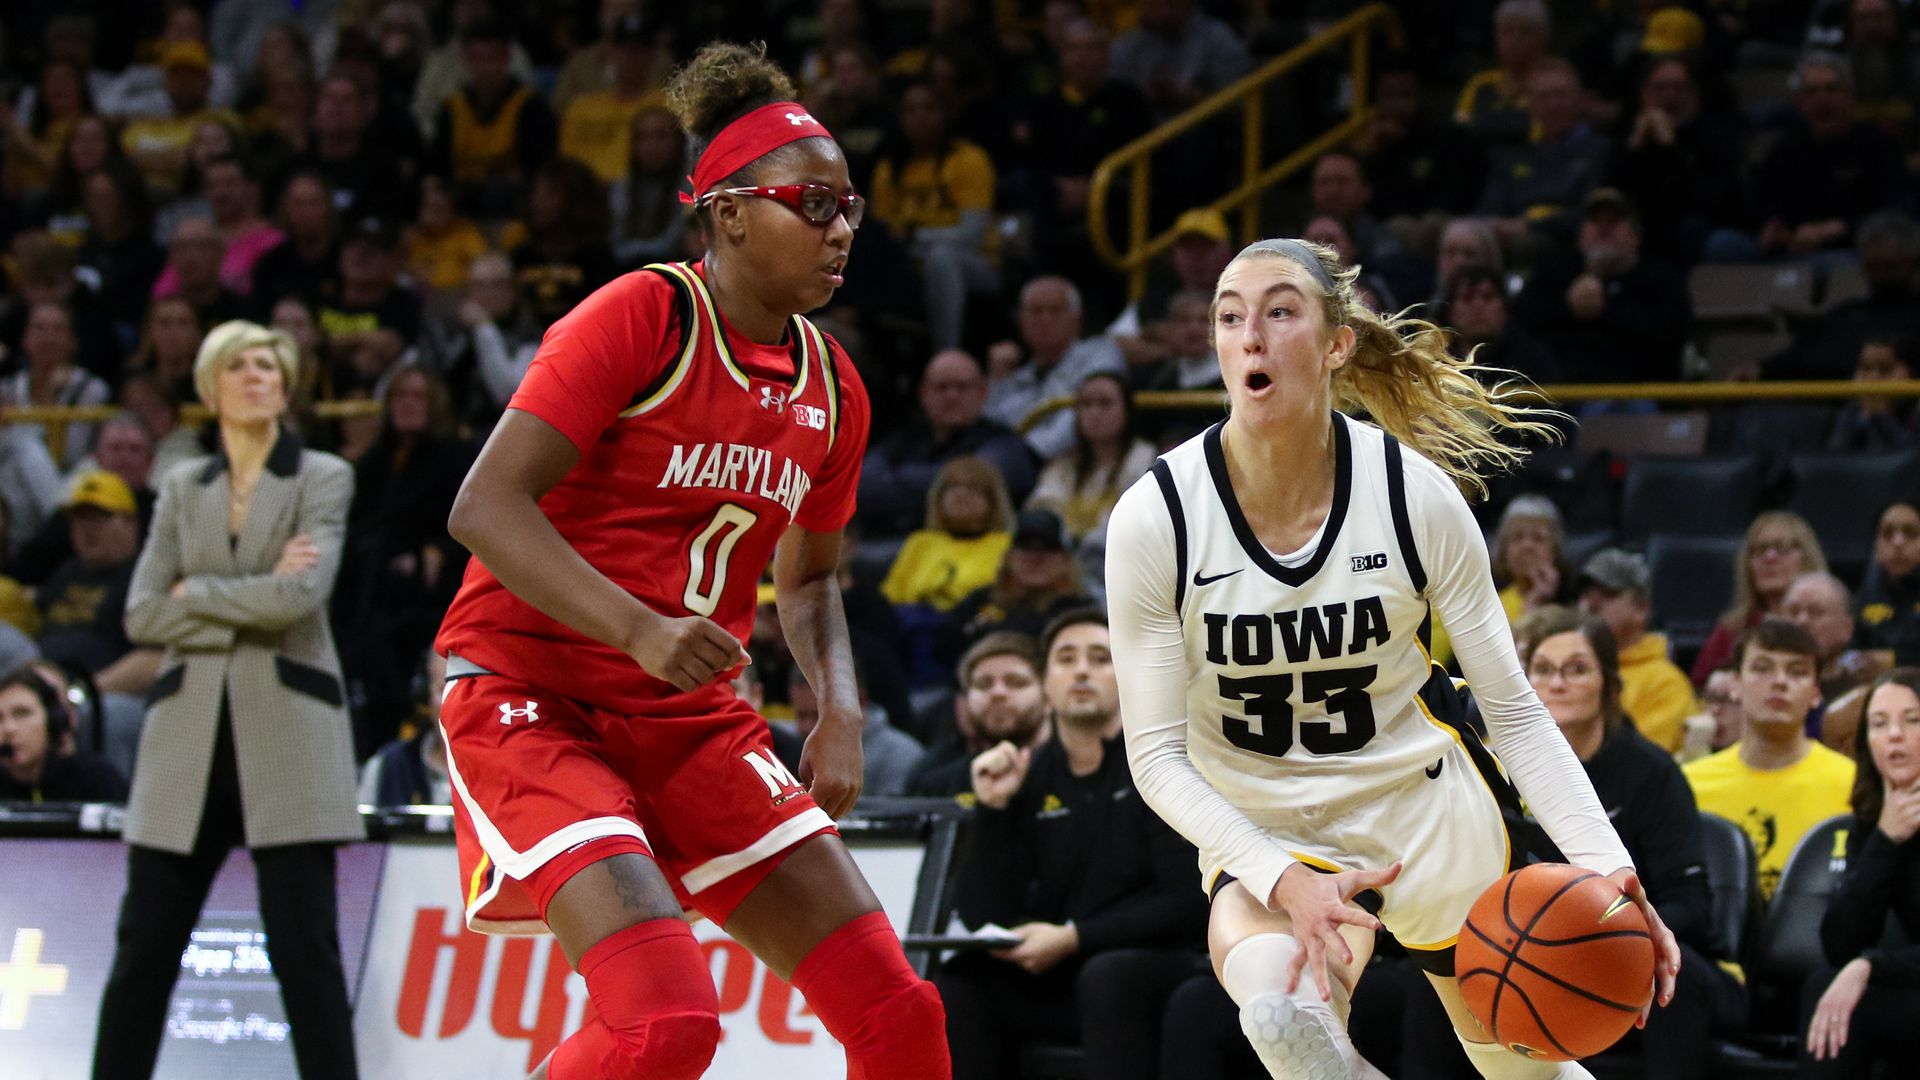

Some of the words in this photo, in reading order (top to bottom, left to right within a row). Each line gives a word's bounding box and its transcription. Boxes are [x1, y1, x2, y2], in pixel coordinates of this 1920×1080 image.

[657, 442, 812, 526] MARYLAN
[683, 502, 758, 618] 0
[1203, 595, 1392, 667] IOWA
[1216, 663, 1379, 758] 33
[741, 747, 802, 799] M
